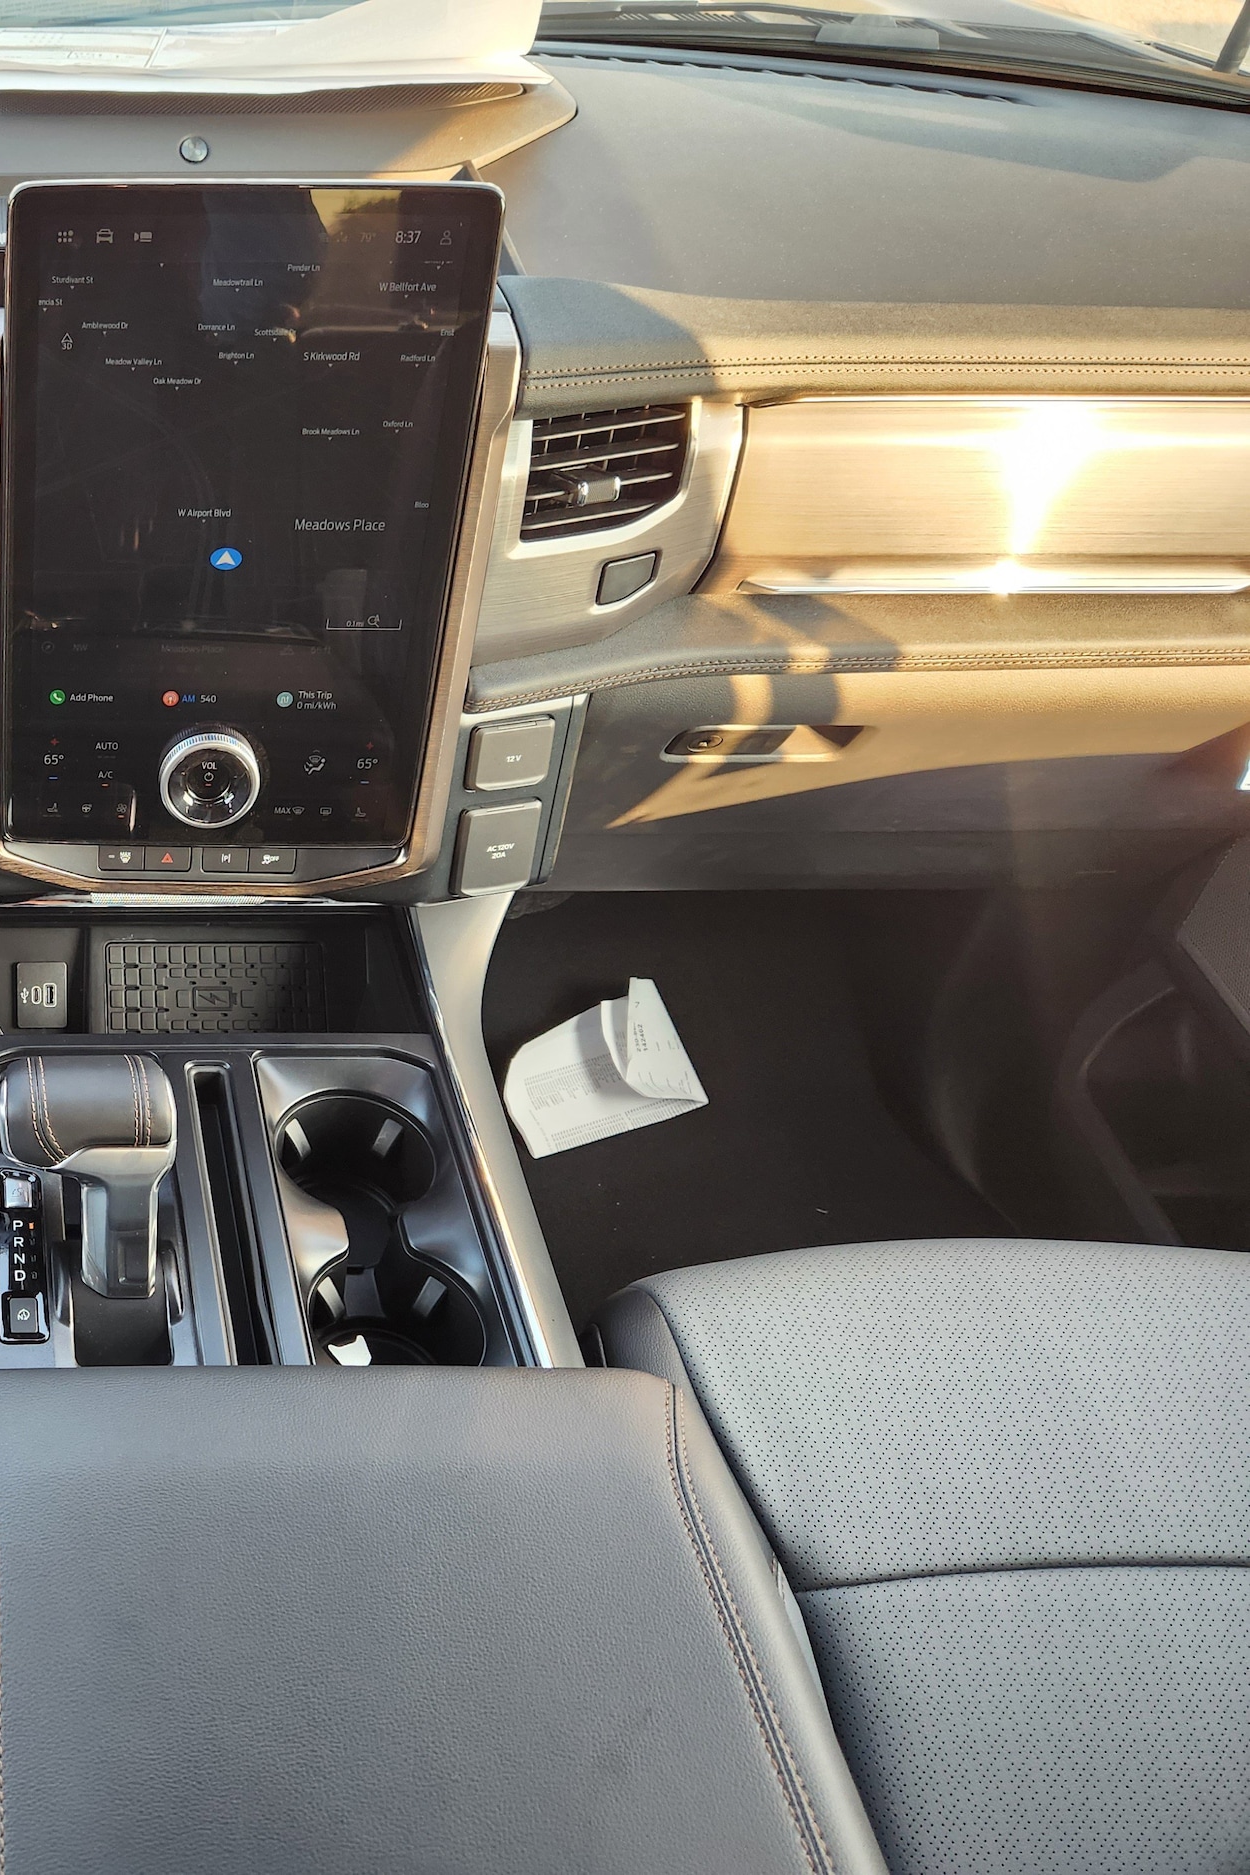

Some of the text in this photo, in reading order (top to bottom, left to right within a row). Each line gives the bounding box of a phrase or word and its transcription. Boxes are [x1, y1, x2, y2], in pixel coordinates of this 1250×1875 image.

[395, 231, 421, 243] 8:37
[287, 264, 310, 272] Pender
[86, 276, 94, 284] St
[213, 278, 263, 287] Meadowtrail Ln
[379, 282, 437, 292] W Bellfort Ave
[81, 322, 128, 330] Amblewood Dr
[198, 323, 236, 331] Dorrance Ln
[218, 352, 254, 361] Brighton Ln
[303, 351, 360, 361] S Kirkwood Rd
[400, 354, 436, 362] Radford Ln
[105, 358, 162, 367] Meadow Valley Ln
[382, 420, 404, 428] Oxford
[302, 428, 320, 436] Brook
[321, 428, 350, 436] Meadows
[178, 508, 232, 519] W Airport Blvd
[294, 518, 386, 531] Meadows Place
[70, 694, 114, 702] Add Phone
[182, 695, 217, 703] AM 540
[298, 691, 333, 701] This Trip
[297, 701, 337, 710] 0 mi/kWh
[95, 742, 119, 750] AUTO
[43, 754, 65, 765] 65°
[357, 758, 379, 770] 65°
[202, 761, 218, 770] VOL
[98, 771, 113, 779] A/C
[274, 806, 291, 815] MAX
[12, 1220, 24, 1231] P
[13, 1237, 24, 1248] R
[14, 1253, 26, 1264] N
[14, 1270, 26, 1281] D
